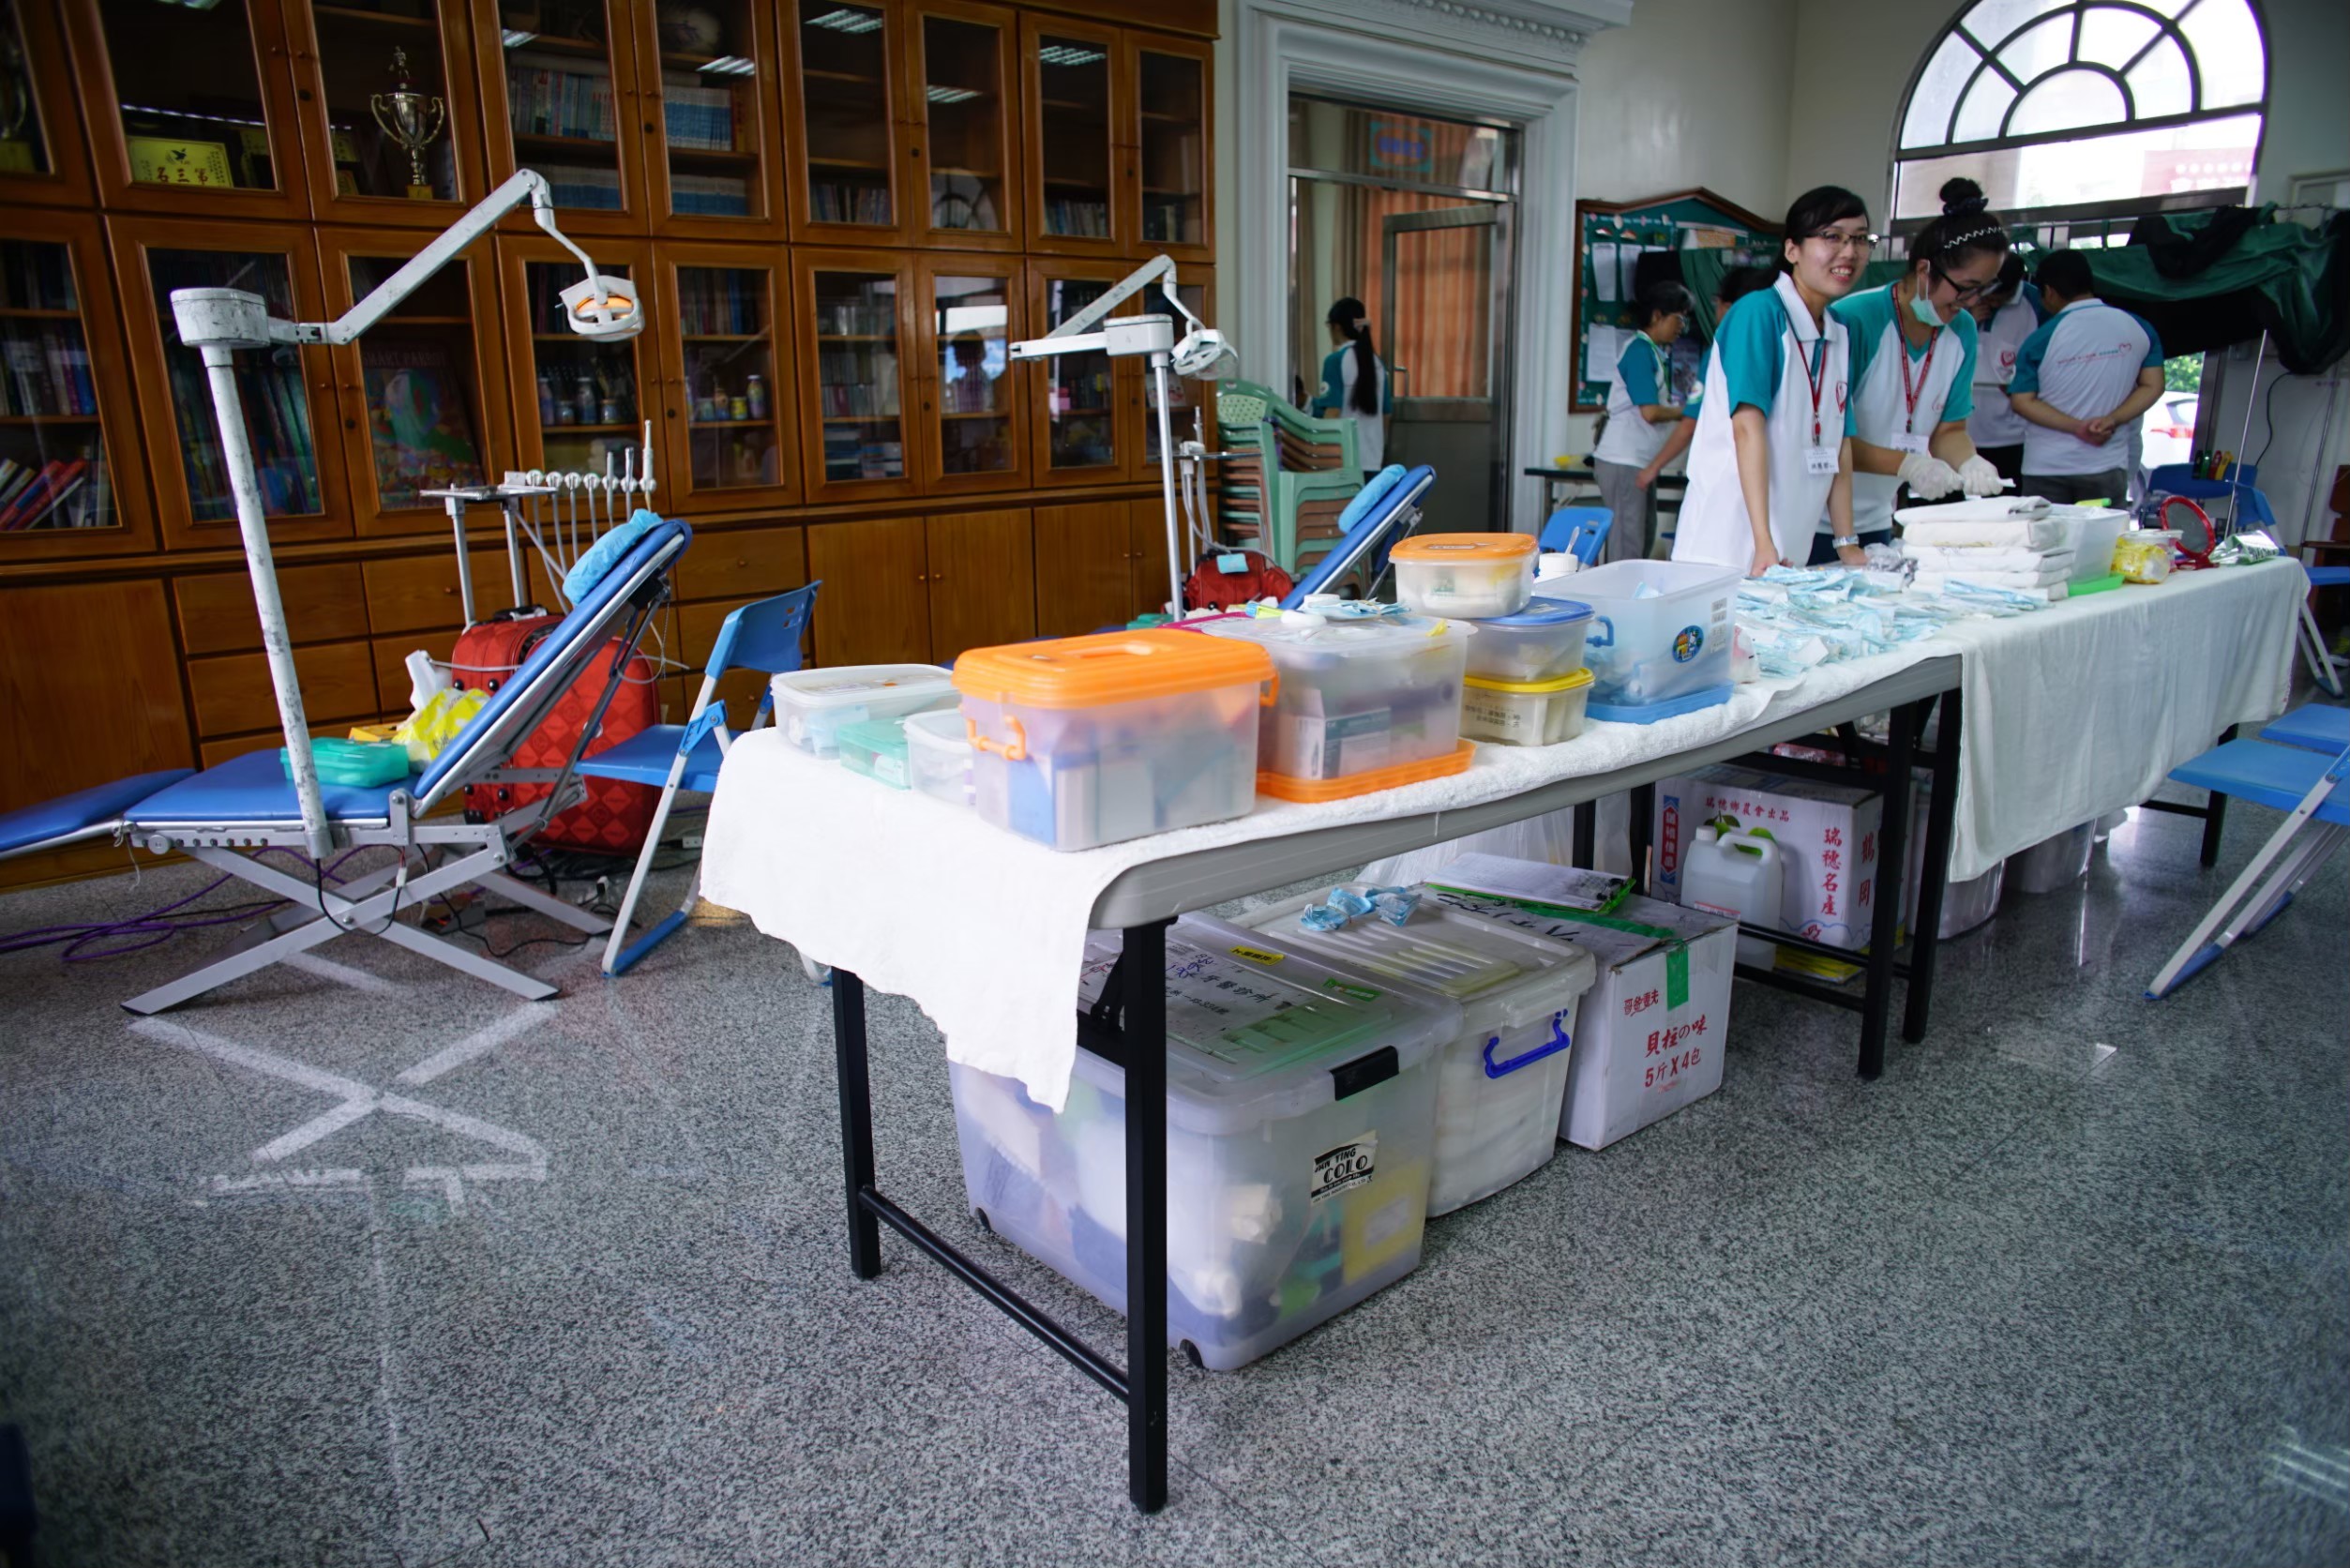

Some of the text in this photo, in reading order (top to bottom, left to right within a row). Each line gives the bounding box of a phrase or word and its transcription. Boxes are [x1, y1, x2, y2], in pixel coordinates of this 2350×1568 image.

[1645, 1014, 1708, 1058] 貝柱の味
[1323, 1154, 1368, 1184] COLO
[1335, 1148, 1356, 1163] YING
